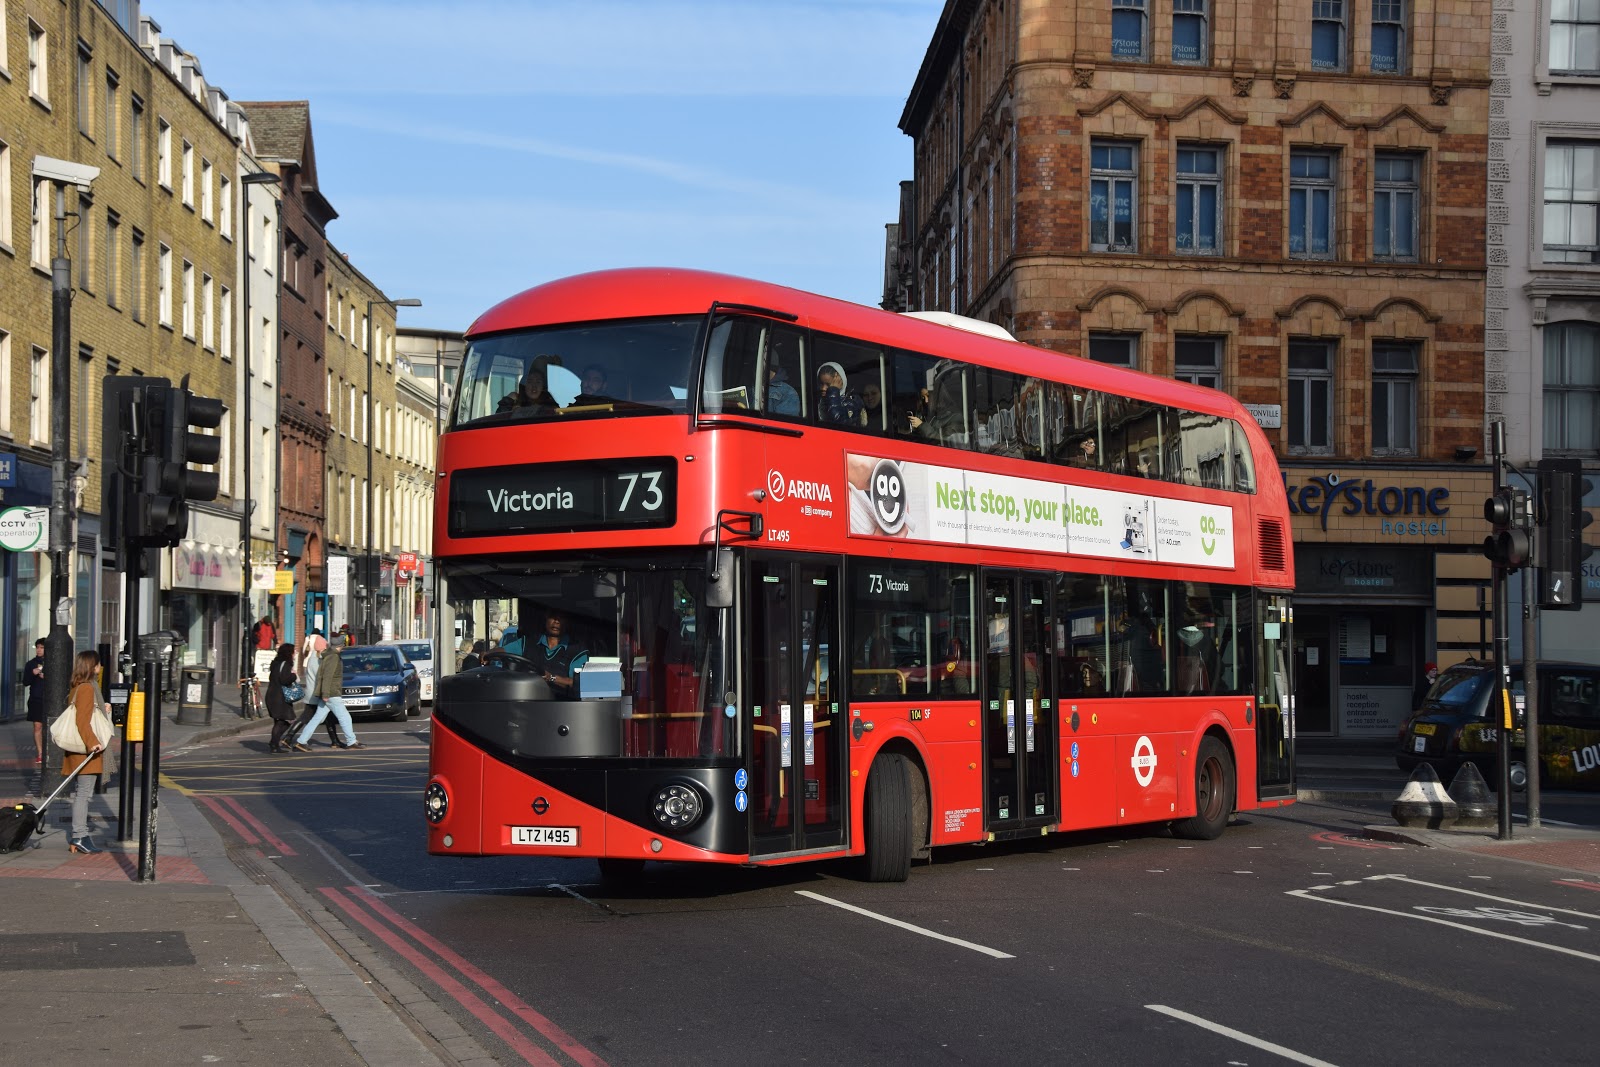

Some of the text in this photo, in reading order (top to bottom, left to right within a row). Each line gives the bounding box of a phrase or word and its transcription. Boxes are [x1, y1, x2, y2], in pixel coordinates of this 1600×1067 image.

[487, 471, 663, 513] Victoria 73
[788, 480, 832, 502] ARRIVA
[876, 474, 900, 497] ao
[936, 482, 1103, 527] Next stop, your place.
[1282, 472, 1449, 532] keystone
[813, 508, 832, 518] company
[768, 529, 790, 542] LT495
[1382, 519, 1446, 536] hostel
[1320, 556, 1393, 584] keystone
[870, 574, 909, 593] 73 Victoria
[911, 709, 931, 720] 104 SF
[519, 829, 570, 842] LTZ 1495
